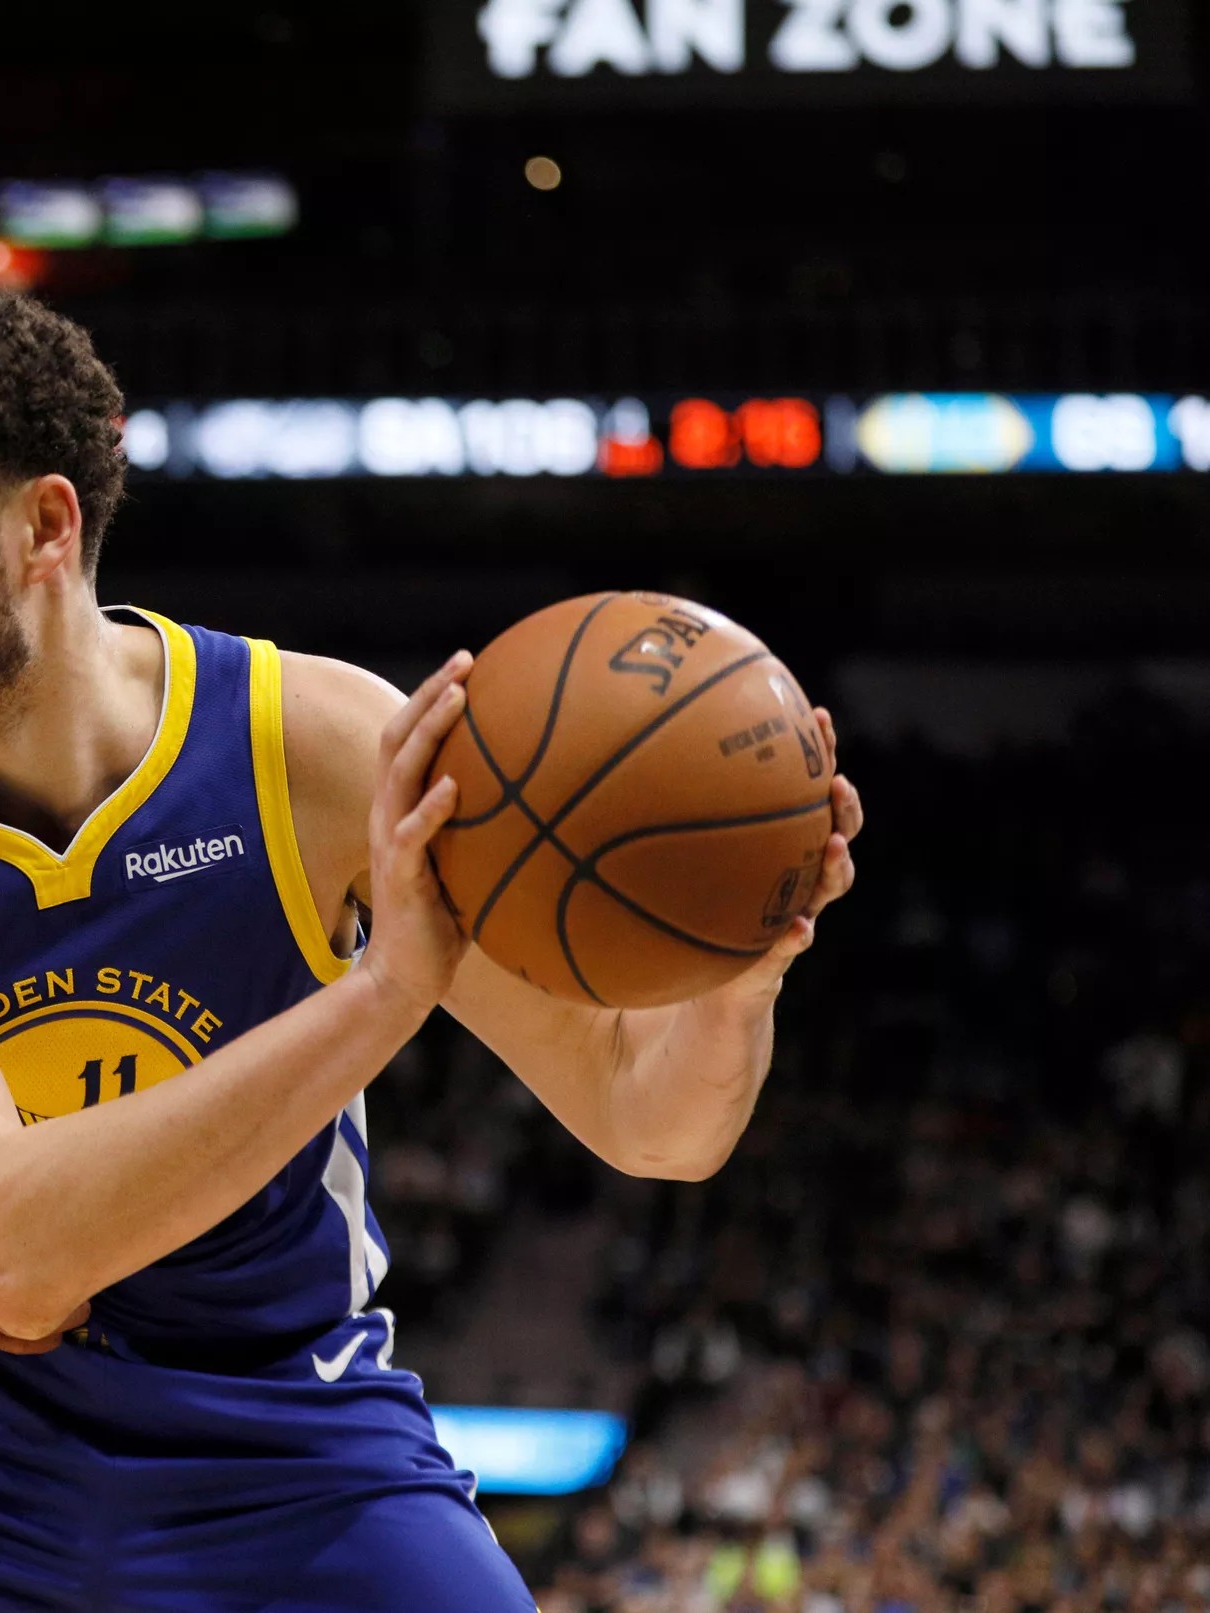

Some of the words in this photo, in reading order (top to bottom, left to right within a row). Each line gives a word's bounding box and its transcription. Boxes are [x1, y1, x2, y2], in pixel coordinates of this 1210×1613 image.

[477, 0, 746, 79] FAN
[768, 0, 1136, 73] ZONE
[125, 833, 245, 881] Rakuten
[95, 967, 225, 1044] STATE
[77, 1053, 139, 1110] 11
